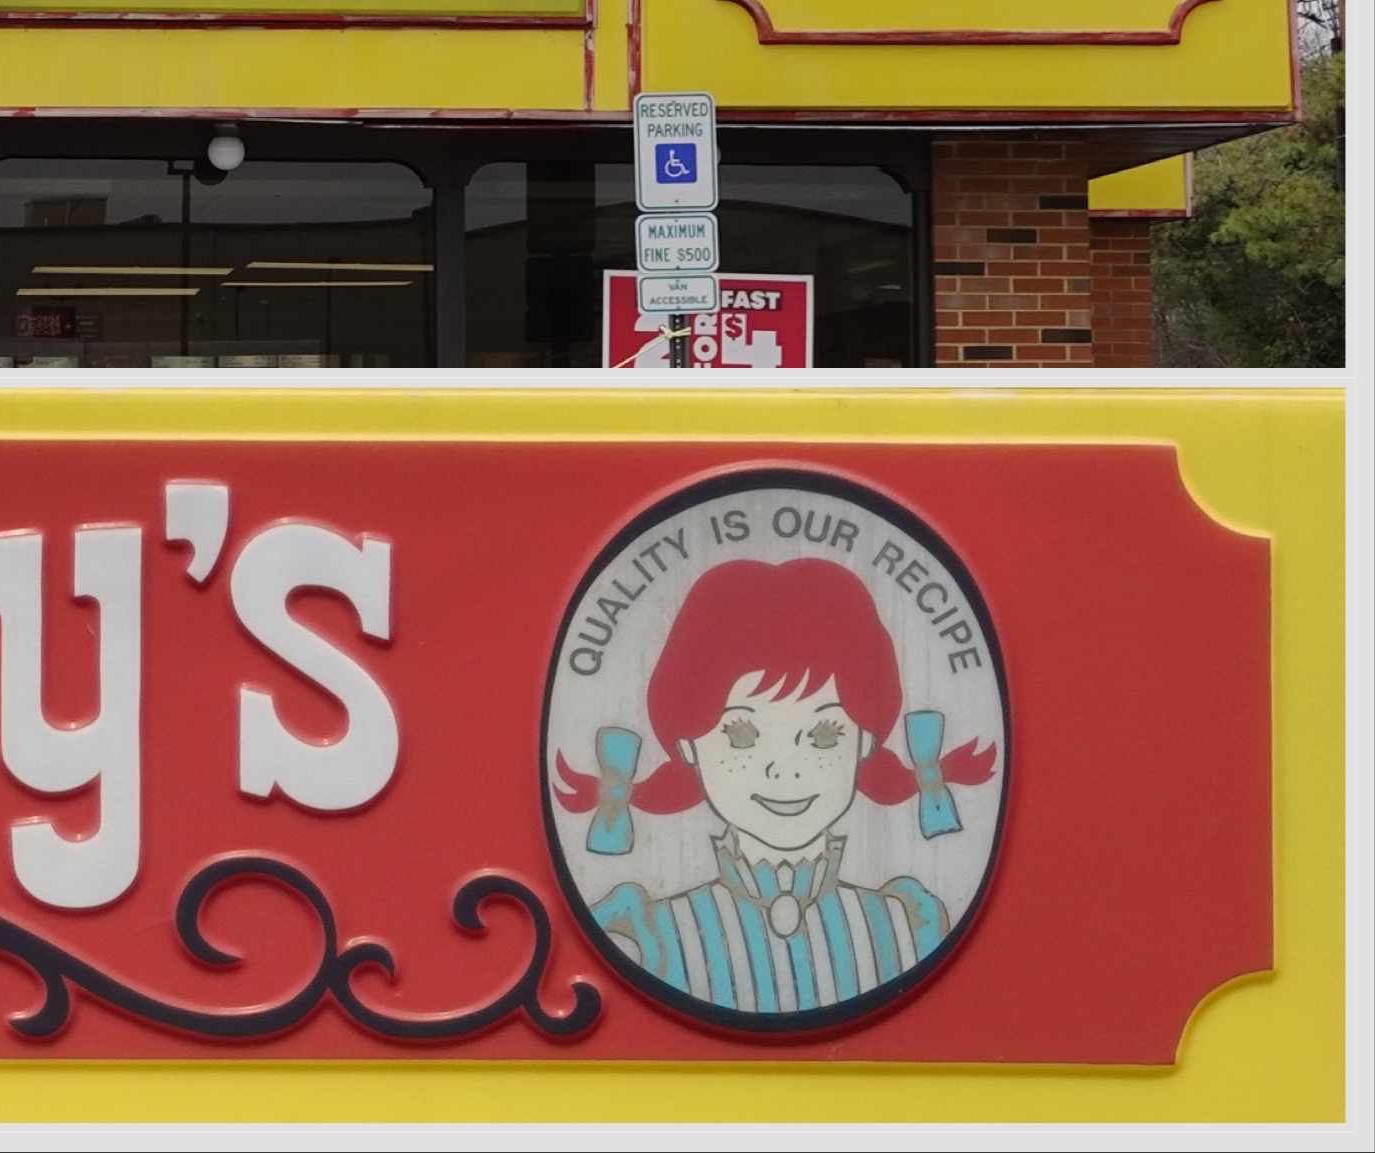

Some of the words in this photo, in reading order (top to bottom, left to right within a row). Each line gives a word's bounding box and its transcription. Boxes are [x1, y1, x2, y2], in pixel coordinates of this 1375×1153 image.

[639, 101, 709, 118] RESERVED
[647, 122, 703, 138] PARKING
[648, 223, 706, 239] MAXIMUM
[644, 247, 671, 263] FINE
[678, 246, 711, 262] $500
[668, 282, 688, 291] VAN
[649, 295, 708, 306] ACCESSIBLE
[692, 313, 719, 368] OR
[569, 528, 692, 676] QUALITY
[709, 509, 750, 547] IS
[772, 506, 861, 552] OUR
[871, 539, 982, 675] RECIPE
